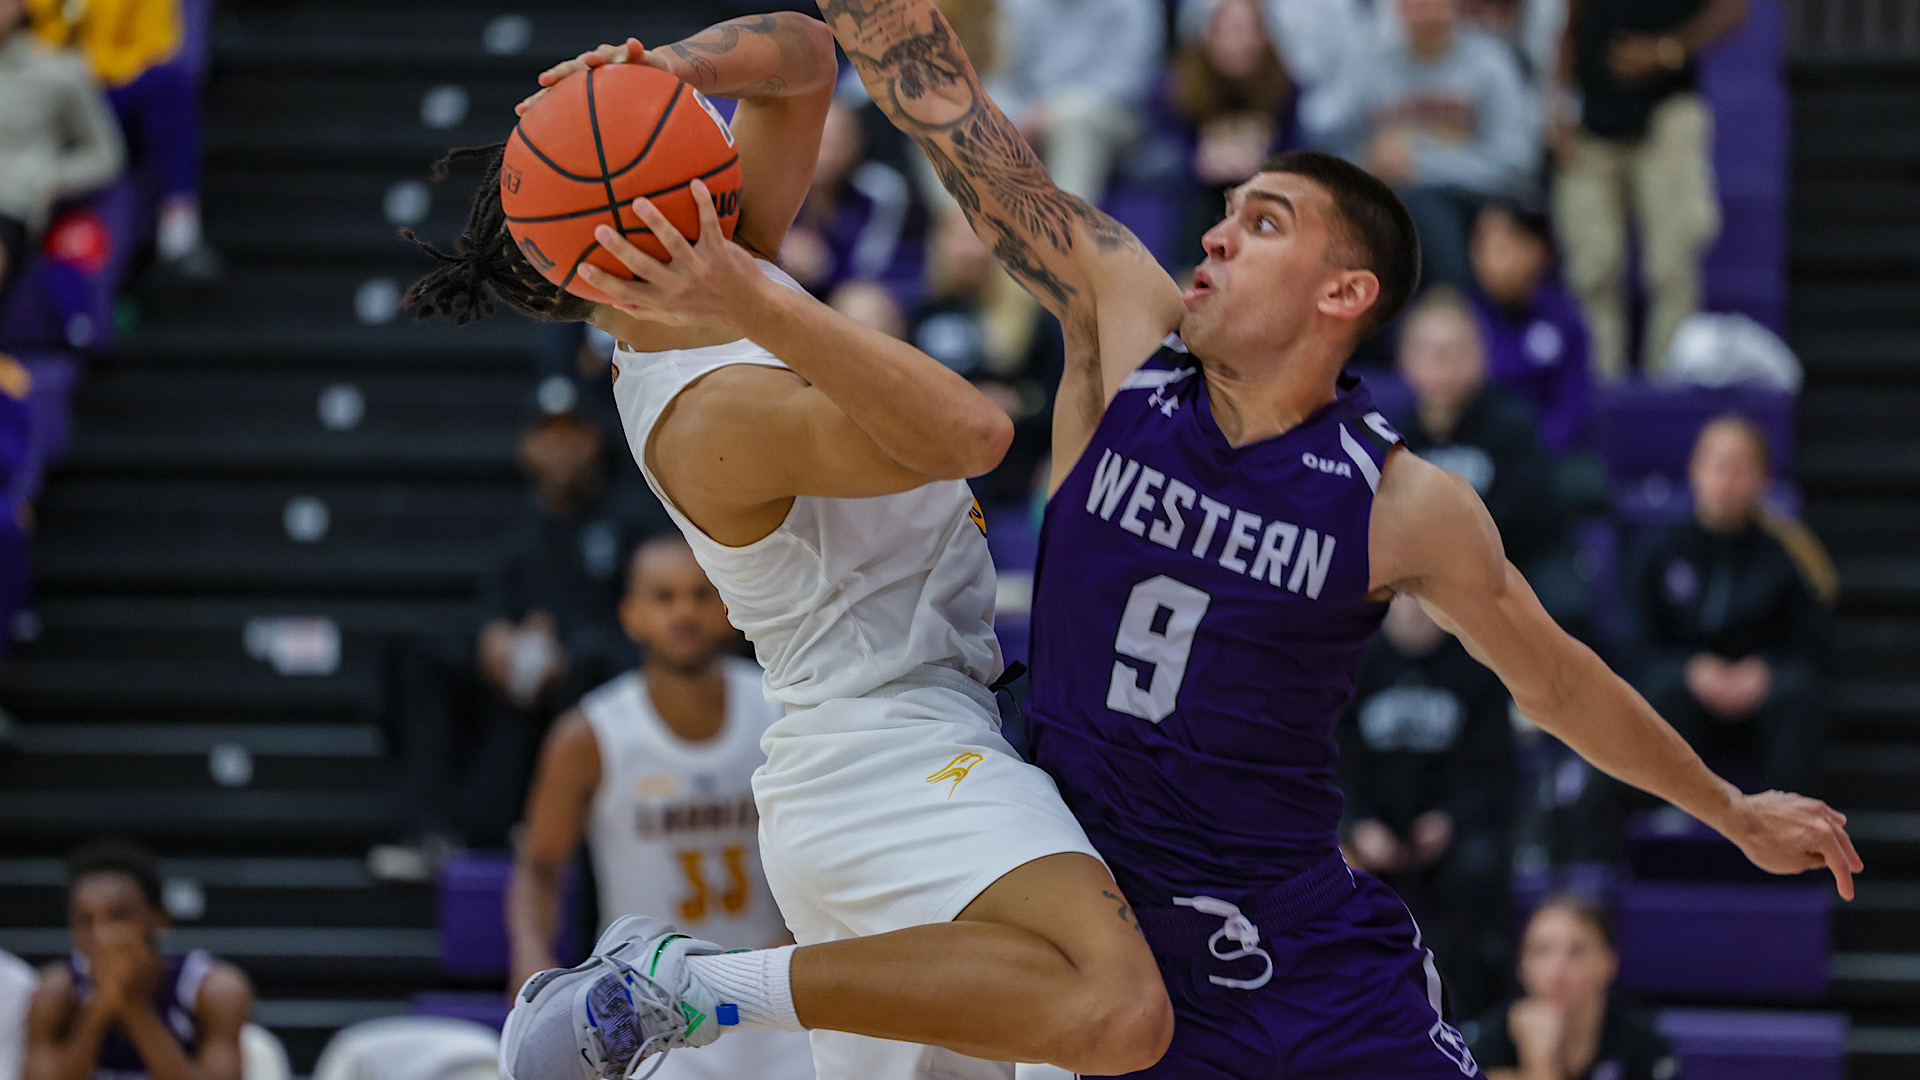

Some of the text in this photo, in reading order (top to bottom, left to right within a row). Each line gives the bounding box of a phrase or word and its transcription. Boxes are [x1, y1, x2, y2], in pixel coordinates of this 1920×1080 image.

[1086, 447, 1337, 601] WESTERN
[1301, 451, 1352, 479] OUA
[1106, 575, 1211, 724] 9
